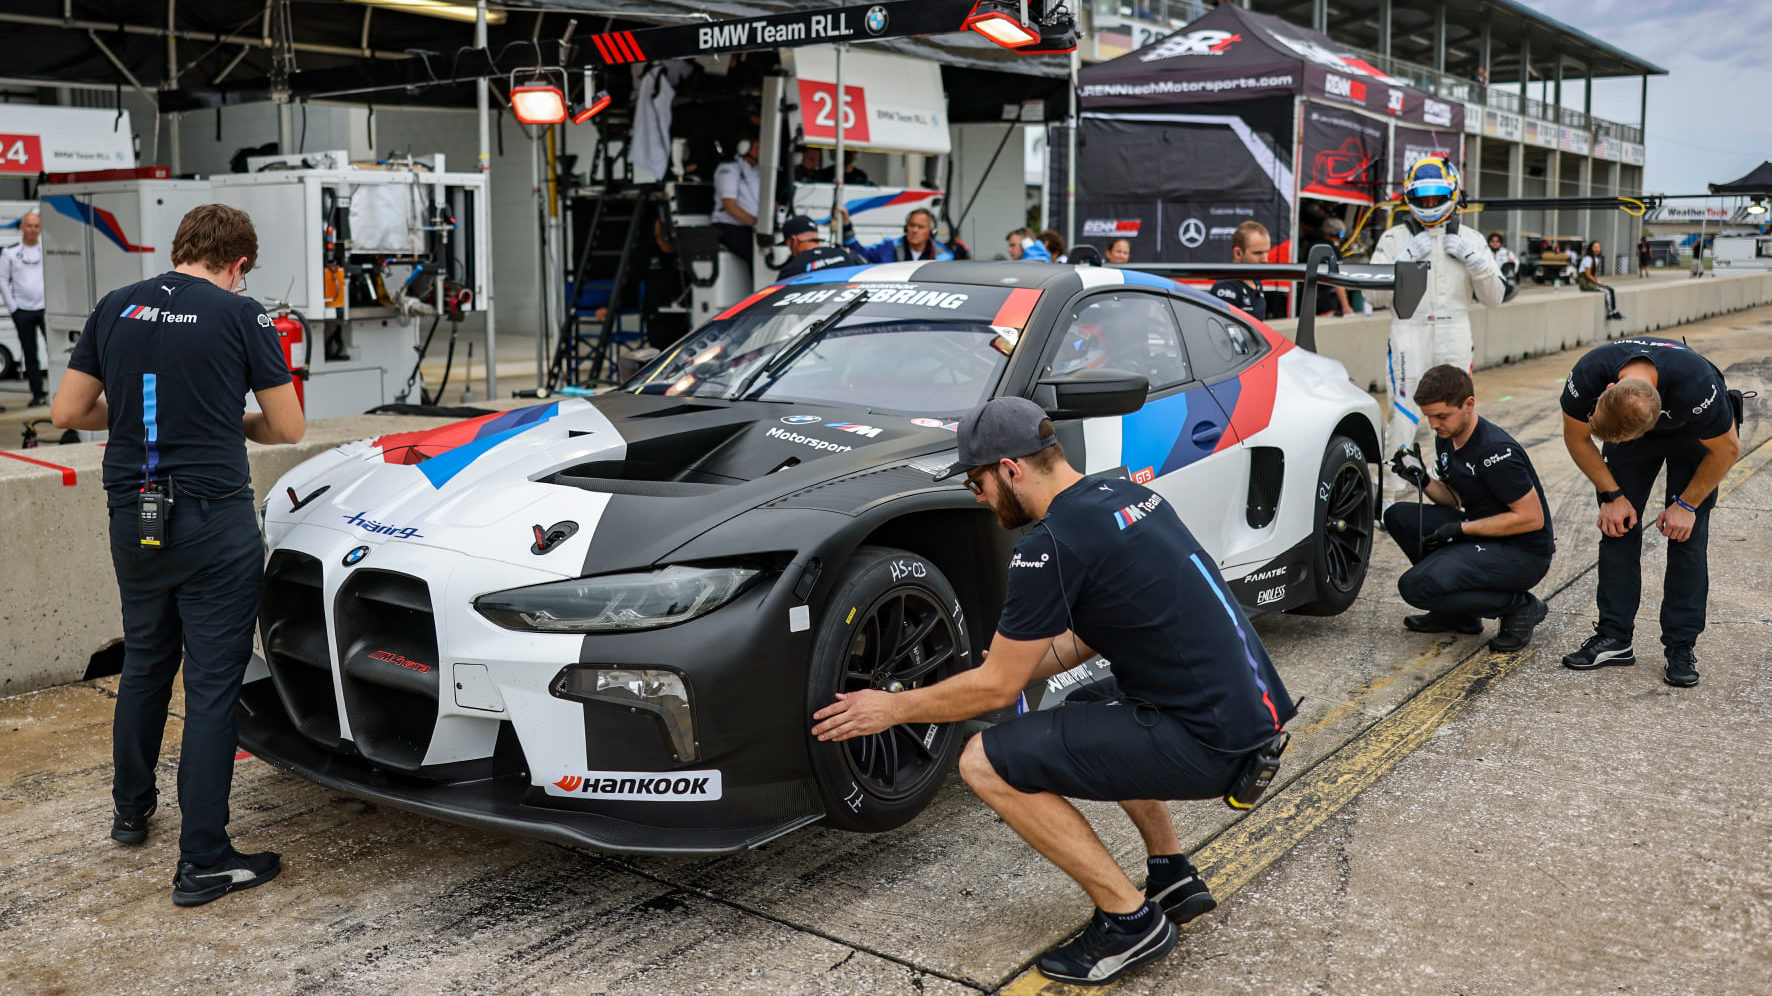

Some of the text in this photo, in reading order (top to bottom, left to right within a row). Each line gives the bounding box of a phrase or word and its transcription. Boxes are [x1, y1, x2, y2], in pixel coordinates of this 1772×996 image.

[699, 23, 749, 49] BMW
[752, 21, 805, 43] Team
[813, 90, 857, 129] 25
[772, 287, 969, 310] 24H SEBRING
[161, 311, 198, 323] Team
[766, 427, 853, 454] Motorsport
[1135, 470, 1152, 484] GT3
[1137, 493, 1162, 513] Team
[1244, 565, 1288, 583] FANATEC
[1256, 583, 1287, 605] ENDLESS
